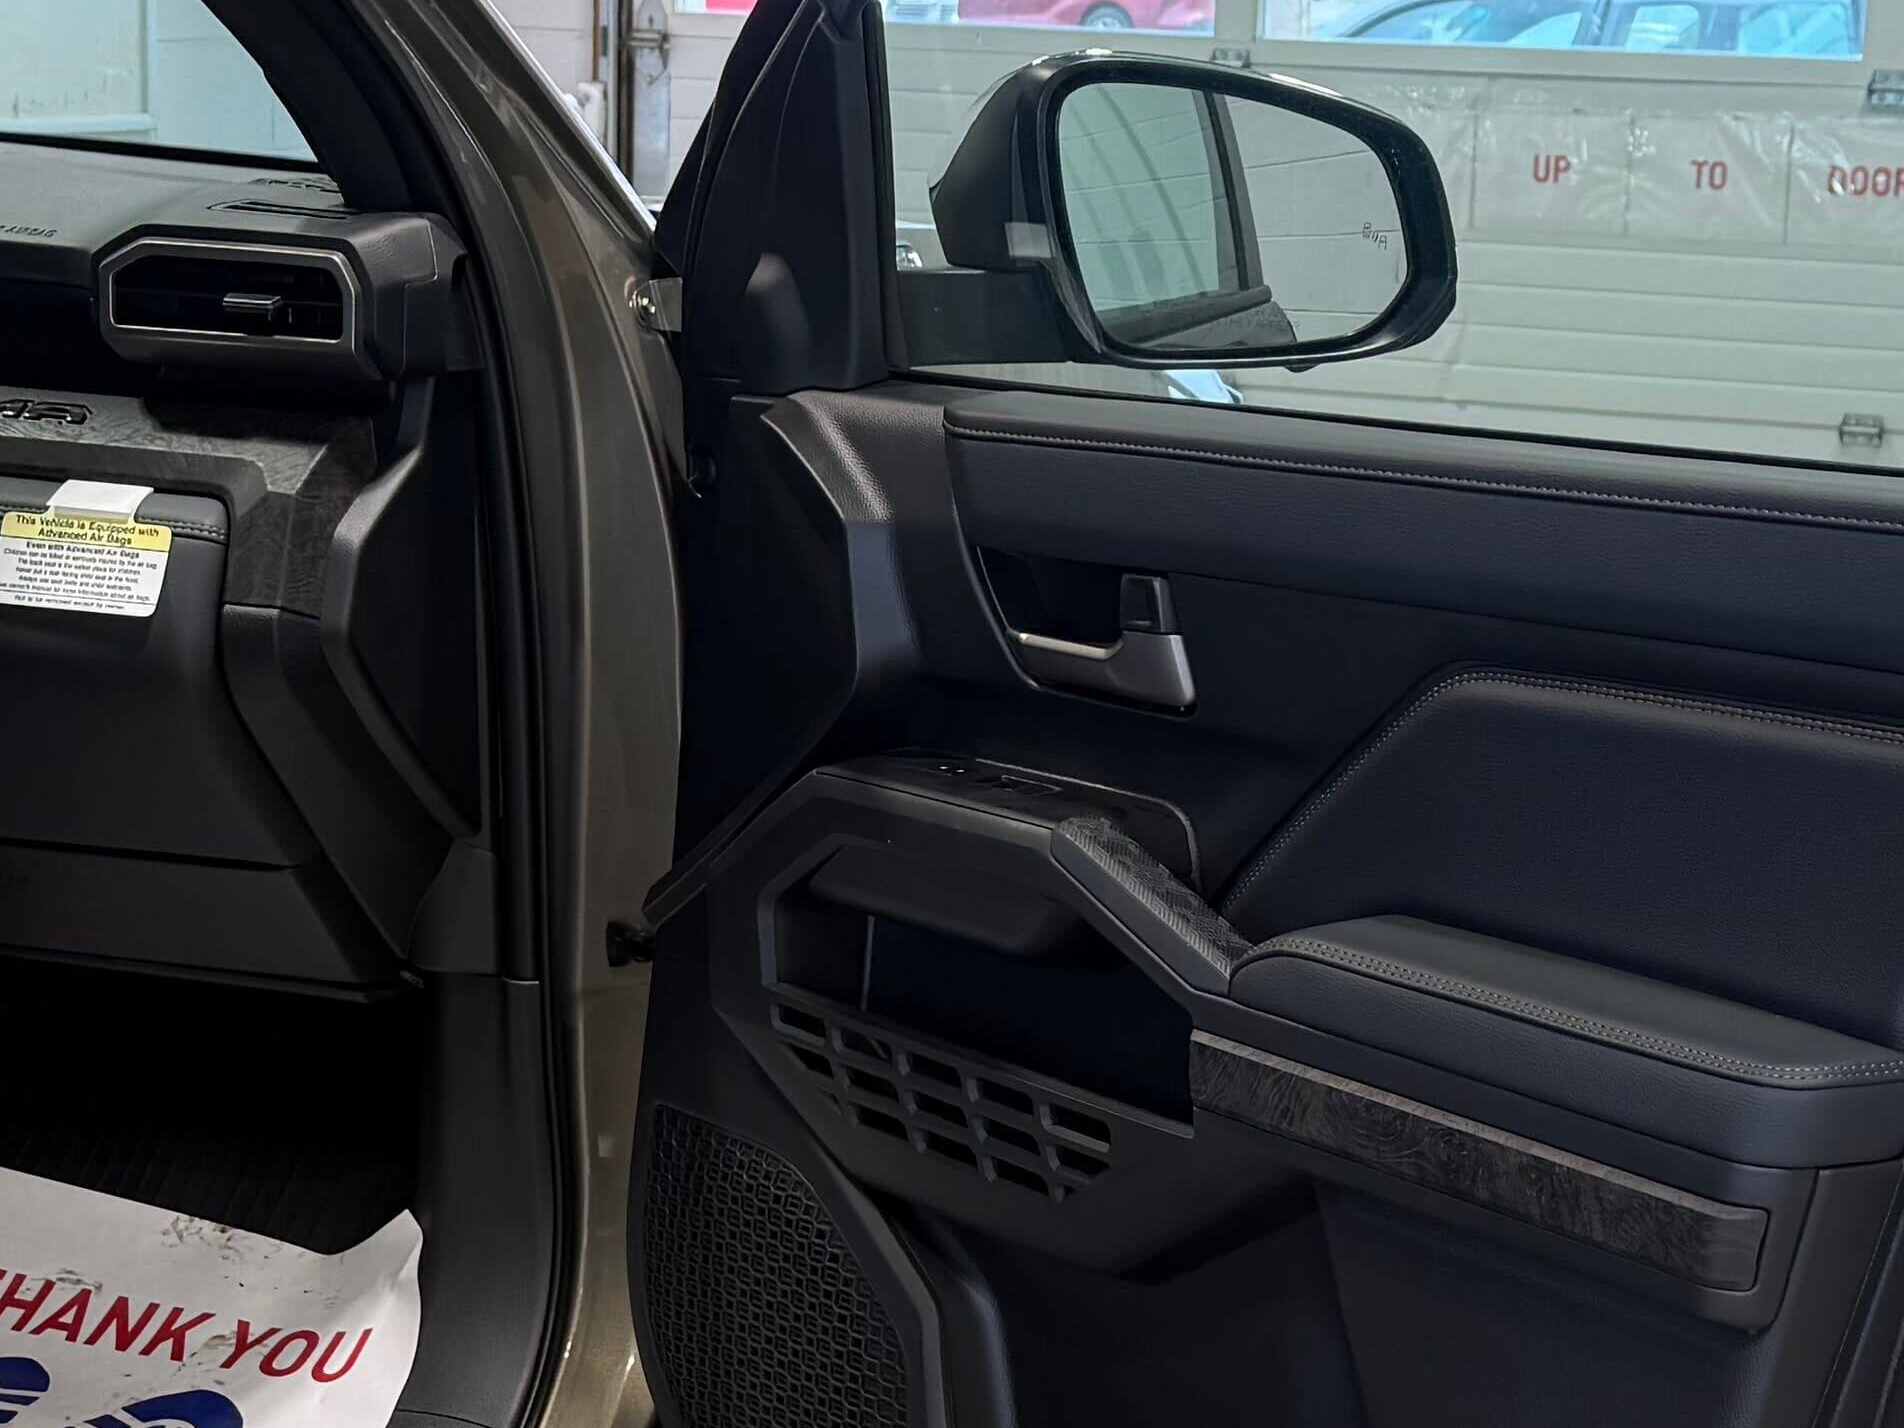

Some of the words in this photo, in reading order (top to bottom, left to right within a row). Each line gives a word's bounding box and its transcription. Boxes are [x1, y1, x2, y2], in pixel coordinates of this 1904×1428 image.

[1531, 154, 1572, 184] UP
[1690, 159, 1728, 191] TO
[16, 514, 36, 525] This
[40, 517, 75, 529] Vehicle
[38, 528, 88, 541] Advanced
[222, 1320, 373, 1384] YOU
